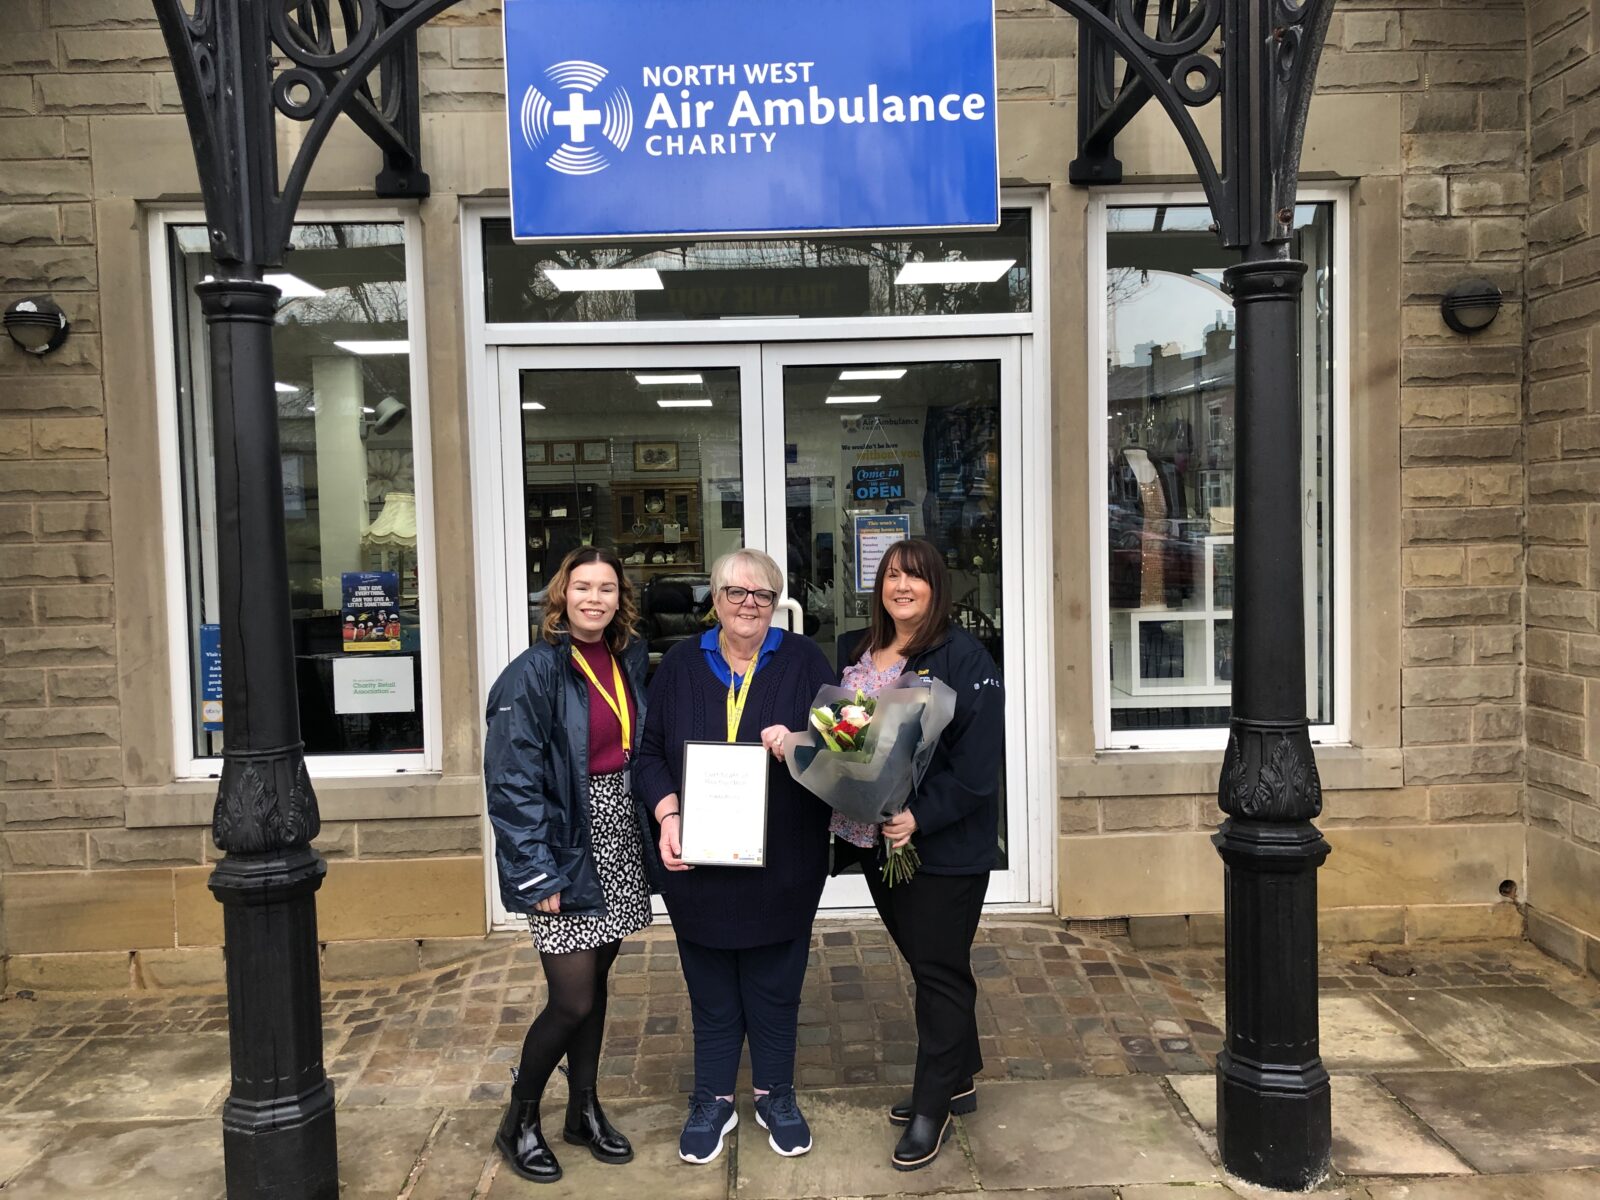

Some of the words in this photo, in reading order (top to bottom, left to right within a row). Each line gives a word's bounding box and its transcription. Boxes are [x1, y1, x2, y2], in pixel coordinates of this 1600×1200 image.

[643, 64, 736, 87] NORTH
[743, 61, 815, 84] WEST
[644, 89, 715, 130] Air
[727, 84, 986, 128] Ambulance
[645, 132, 777, 157] CHARITY
[857, 469, 885, 482] Come
[888, 467, 899, 477] in
[856, 485, 902, 499] OPEN
